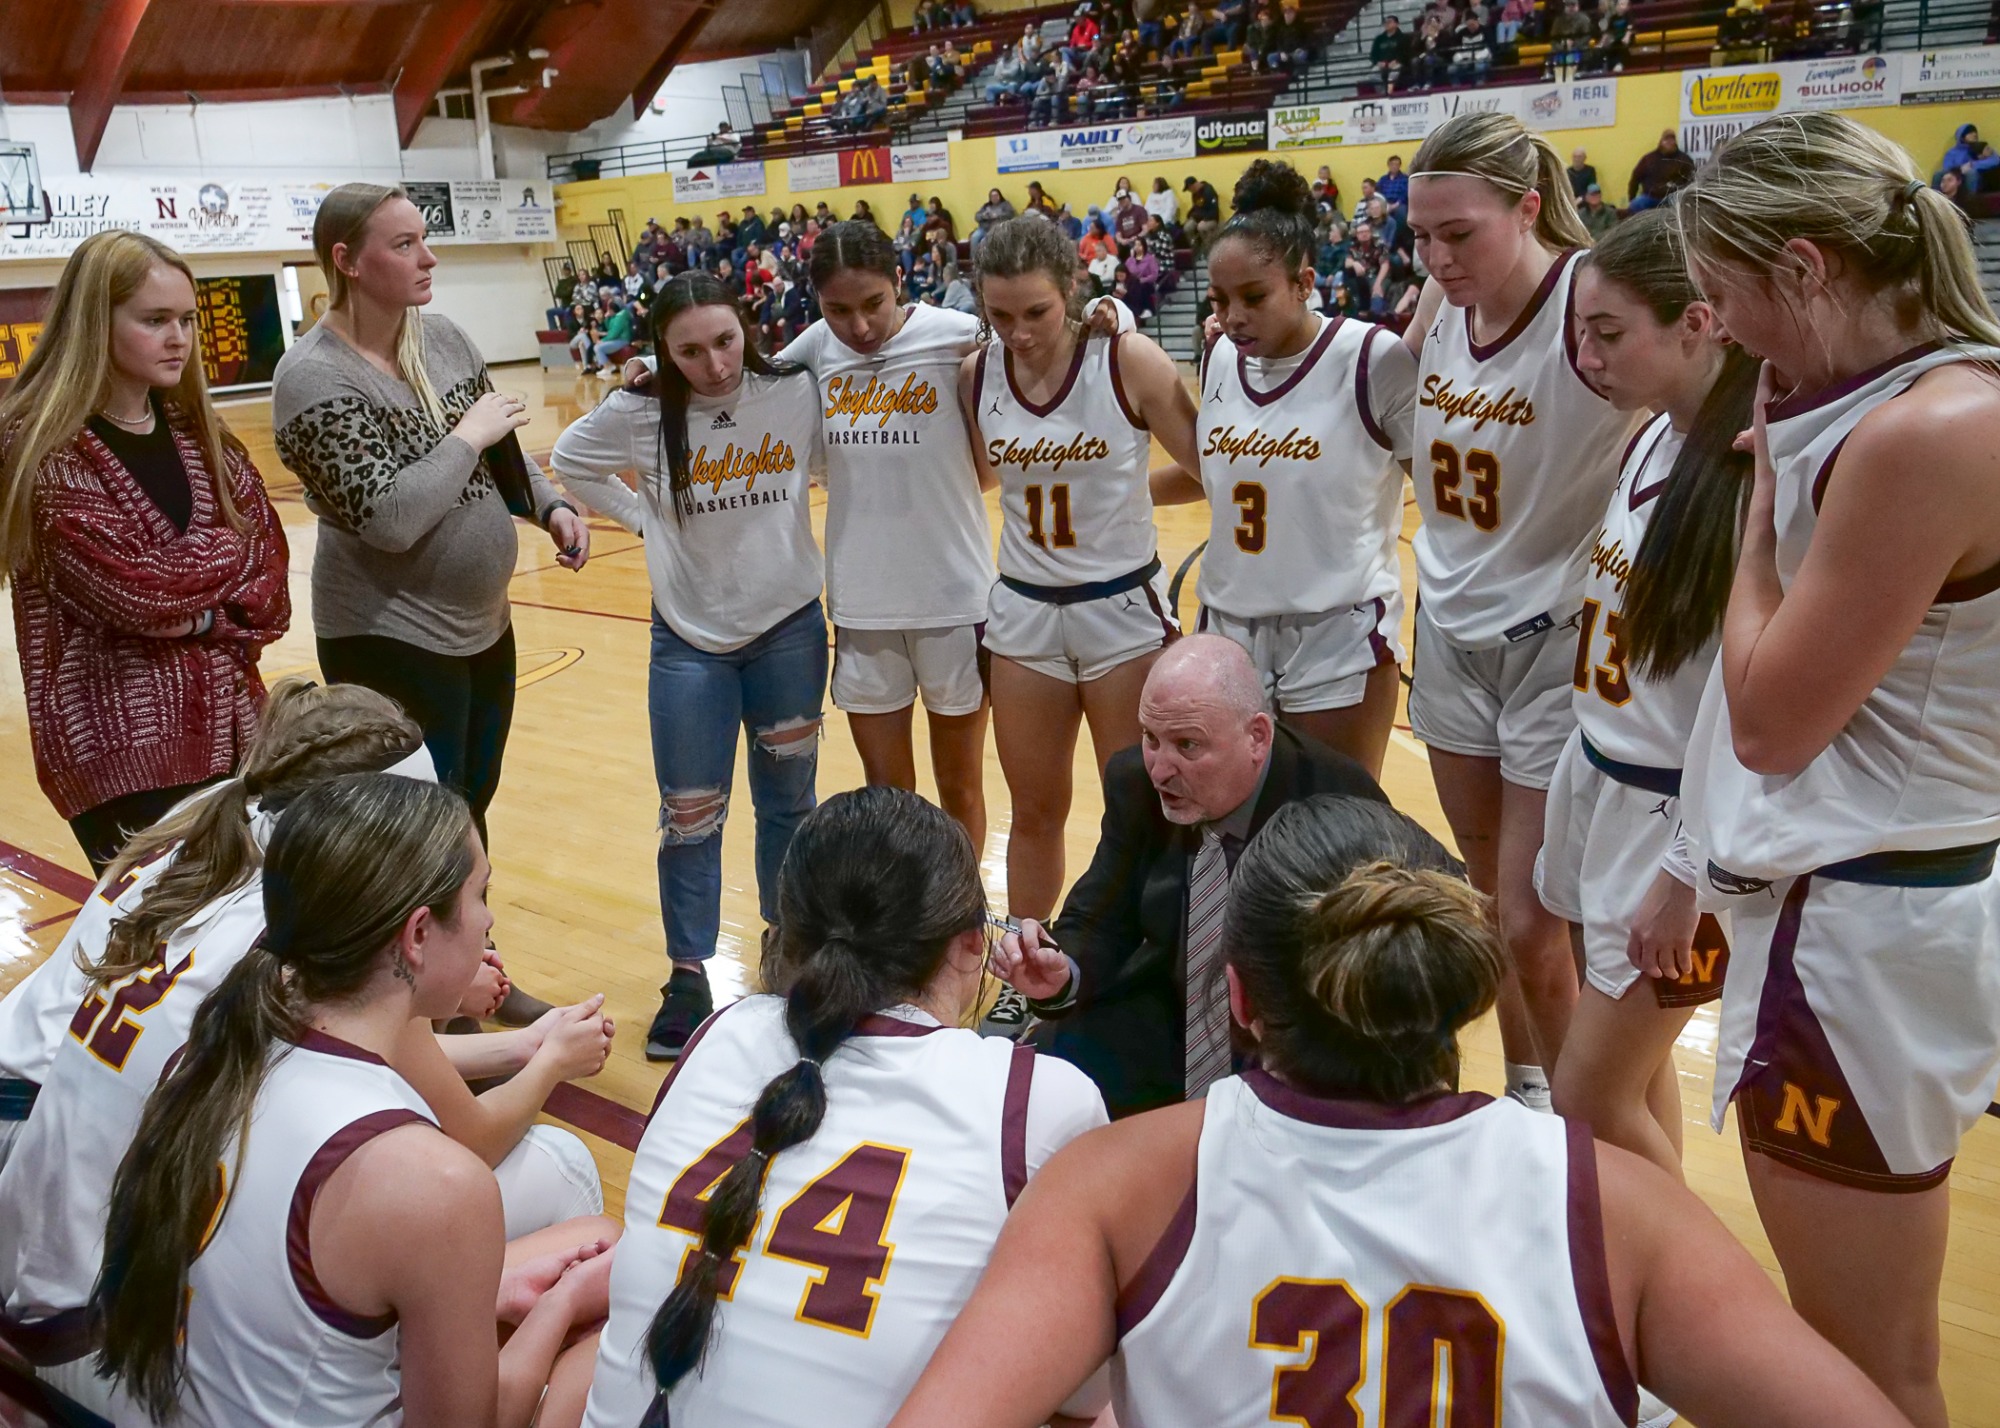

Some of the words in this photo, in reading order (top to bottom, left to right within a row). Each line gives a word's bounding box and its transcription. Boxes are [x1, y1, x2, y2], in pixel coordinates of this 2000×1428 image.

[1686, 72, 1779, 112] Northern
[1797, 77, 1886, 97] BULLHOOK
[1060, 128, 1123, 147] NAULT
[1197, 121, 1260, 139] altana
[52, 194, 110, 218] LLEY
[156, 197, 177, 219] N
[418, 205, 443, 225] 06
[825, 371, 939, 428] Skylights
[1419, 373, 1536, 432] Skylights
[710, 421, 737, 431] adidas
[828, 429, 921, 445] BASKETBALL
[1203, 424, 1322, 468] Skylights
[686, 432, 796, 496] kylights
[988, 431, 1110, 472] Skylights
[685, 488, 790, 516] BASKETBALL
[1430, 438, 1502, 534] 23
[1024, 483, 1077, 550] 11
[1231, 481, 1268, 556] 3
[1534, 616, 1548, 629] XL
[1573, 597, 1633, 708] 13
[1680, 948, 1721, 985] N
[1773, 1080, 1841, 1149] N
[656, 1116, 913, 1340] 44
[1248, 1274, 1506, 1428] 30
